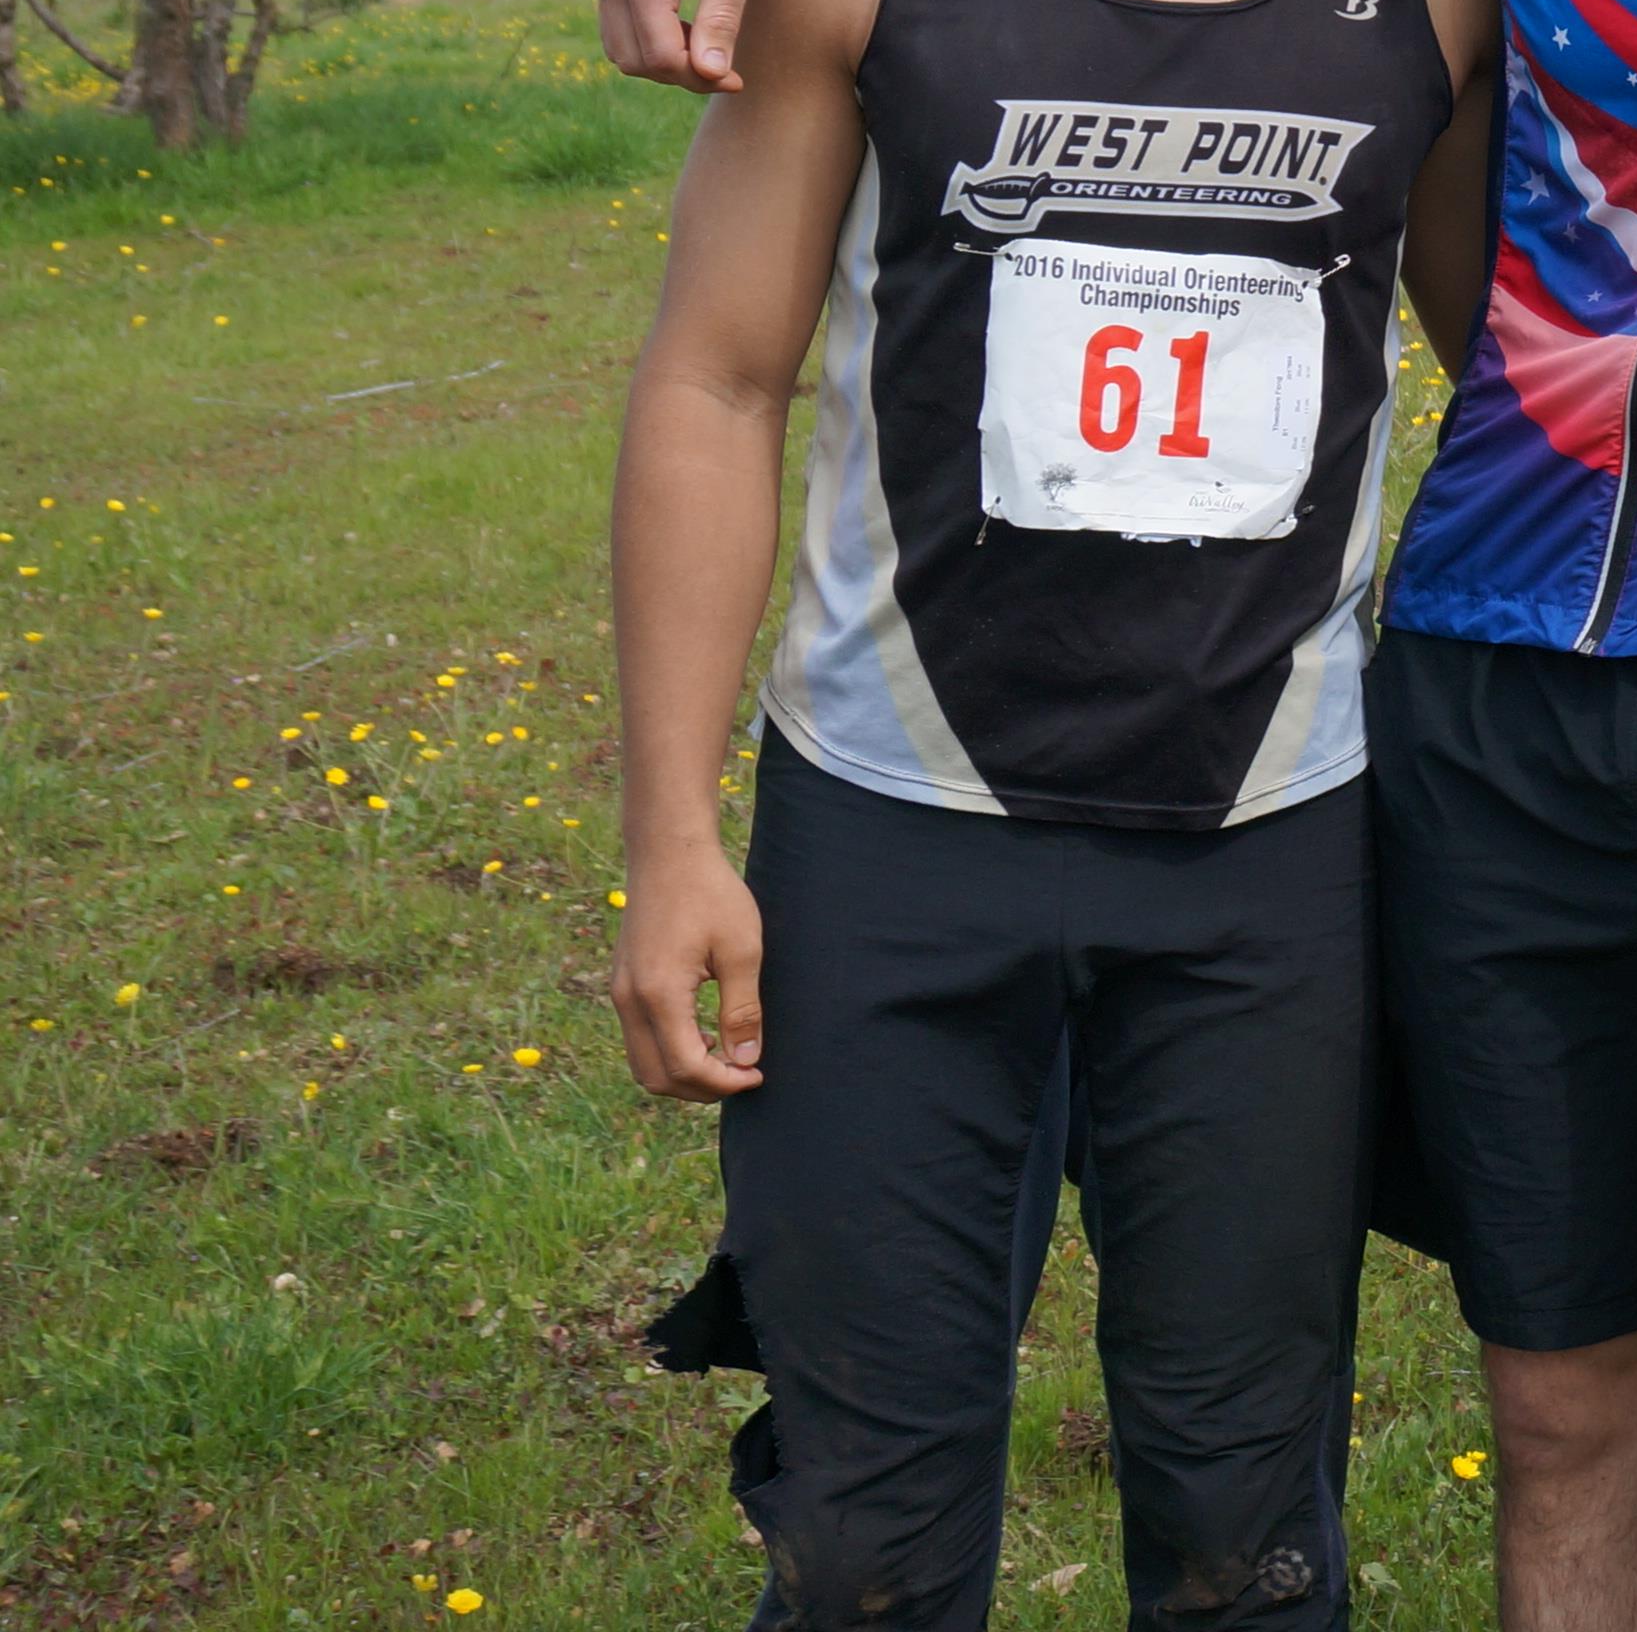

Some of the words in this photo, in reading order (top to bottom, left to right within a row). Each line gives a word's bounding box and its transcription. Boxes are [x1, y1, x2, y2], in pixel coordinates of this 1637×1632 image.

[1008, 113, 1169, 172] WEST
[1180, 121, 1343, 183] POINT
[1050, 181, 1292, 206] ORIENTEERING
[1014, 254, 1064, 279] 2016
[1071, 258, 1177, 289] Individual
[1184, 266, 1305, 304] Orienteering
[1080, 282, 1241, 321] Championships
[1077, 324, 1213, 459] 61
